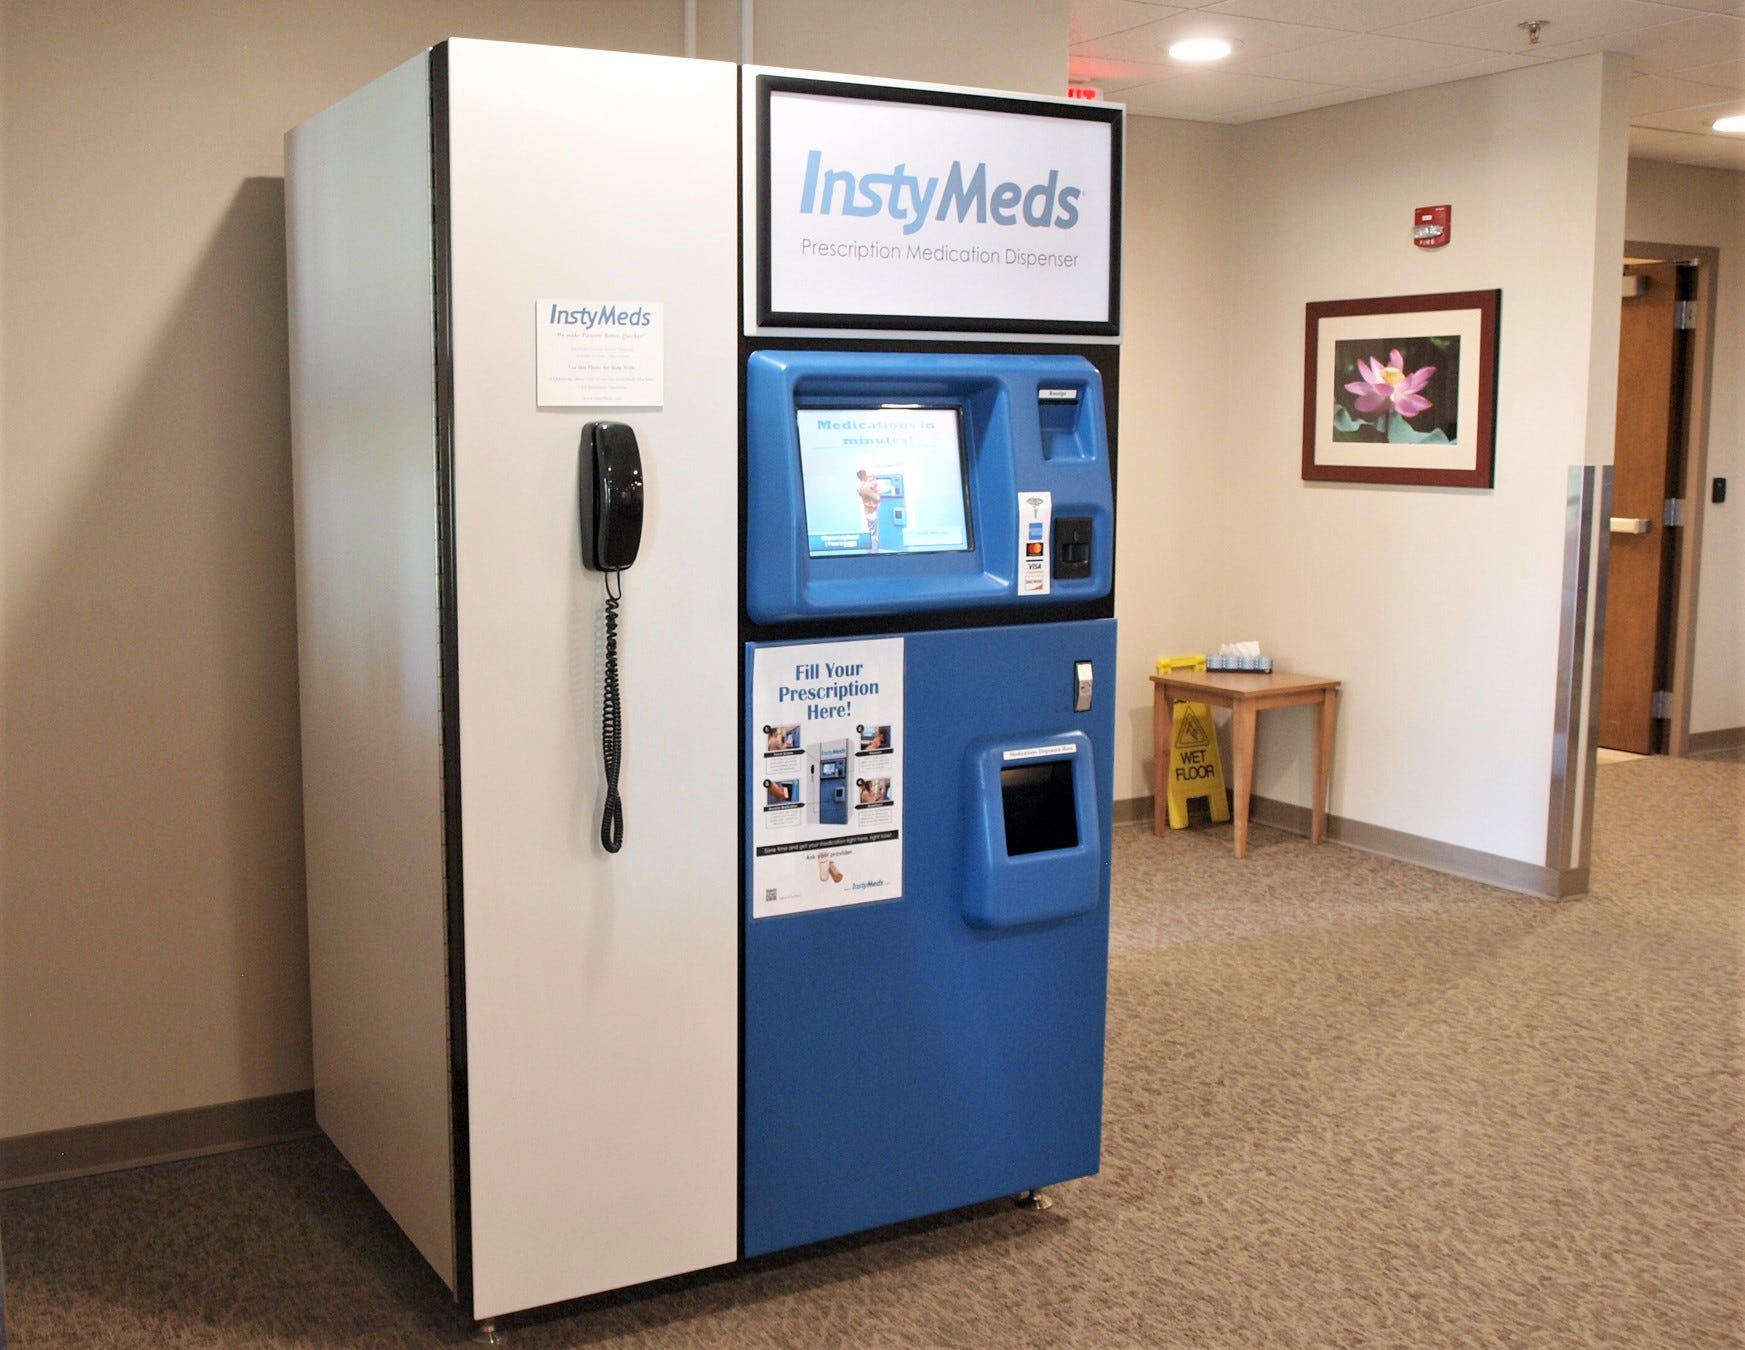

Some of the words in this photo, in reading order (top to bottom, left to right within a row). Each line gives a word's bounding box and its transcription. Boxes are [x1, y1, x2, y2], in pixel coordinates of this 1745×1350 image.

[800, 150, 1082, 235] InstyMeds
[801, 238, 901, 261] Prescription
[906, 244, 1001, 264] Medication
[1004, 248, 1079, 269] Dispenser
[549, 303, 651, 330] InstyMeds
[817, 420, 916, 430] Medications
[920, 420, 935, 430] in
[795, 664, 820, 681] Fill
[825, 662, 864, 678] Your
[778, 680, 879, 703] Prescription
[807, 701, 852, 720] Here!
[1180, 750, 1207, 765] WET
[1176, 765, 1215, 781] FLOOR
